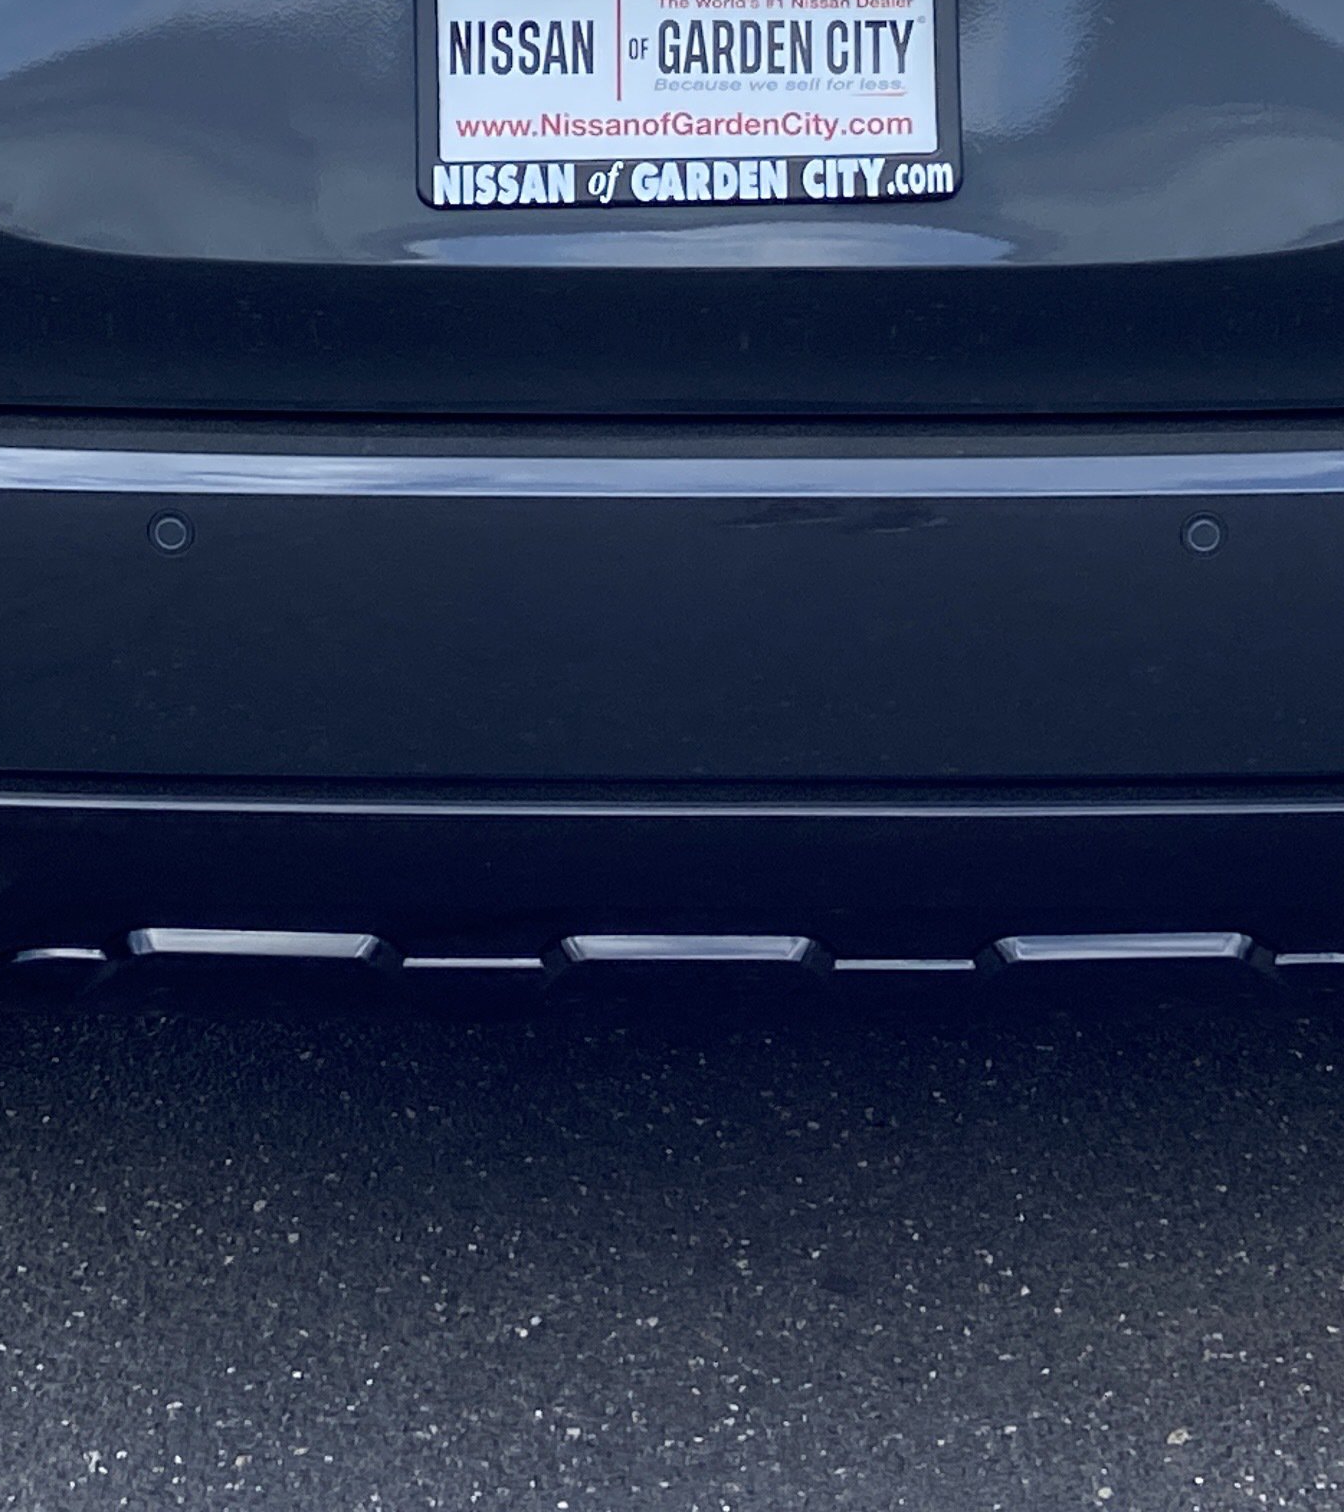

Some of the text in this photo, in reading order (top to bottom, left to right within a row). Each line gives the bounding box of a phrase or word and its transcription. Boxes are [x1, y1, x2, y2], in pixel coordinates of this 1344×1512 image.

[449, 19, 914, 75] NISSAN OF GARDEN CITY
[654, 77, 906, 91] Because we sell for less.
[456, 112, 913, 142] www.NissanofGardenCity.com
[433, 158, 954, 205] NISSAN of GARDEN CITY.com
